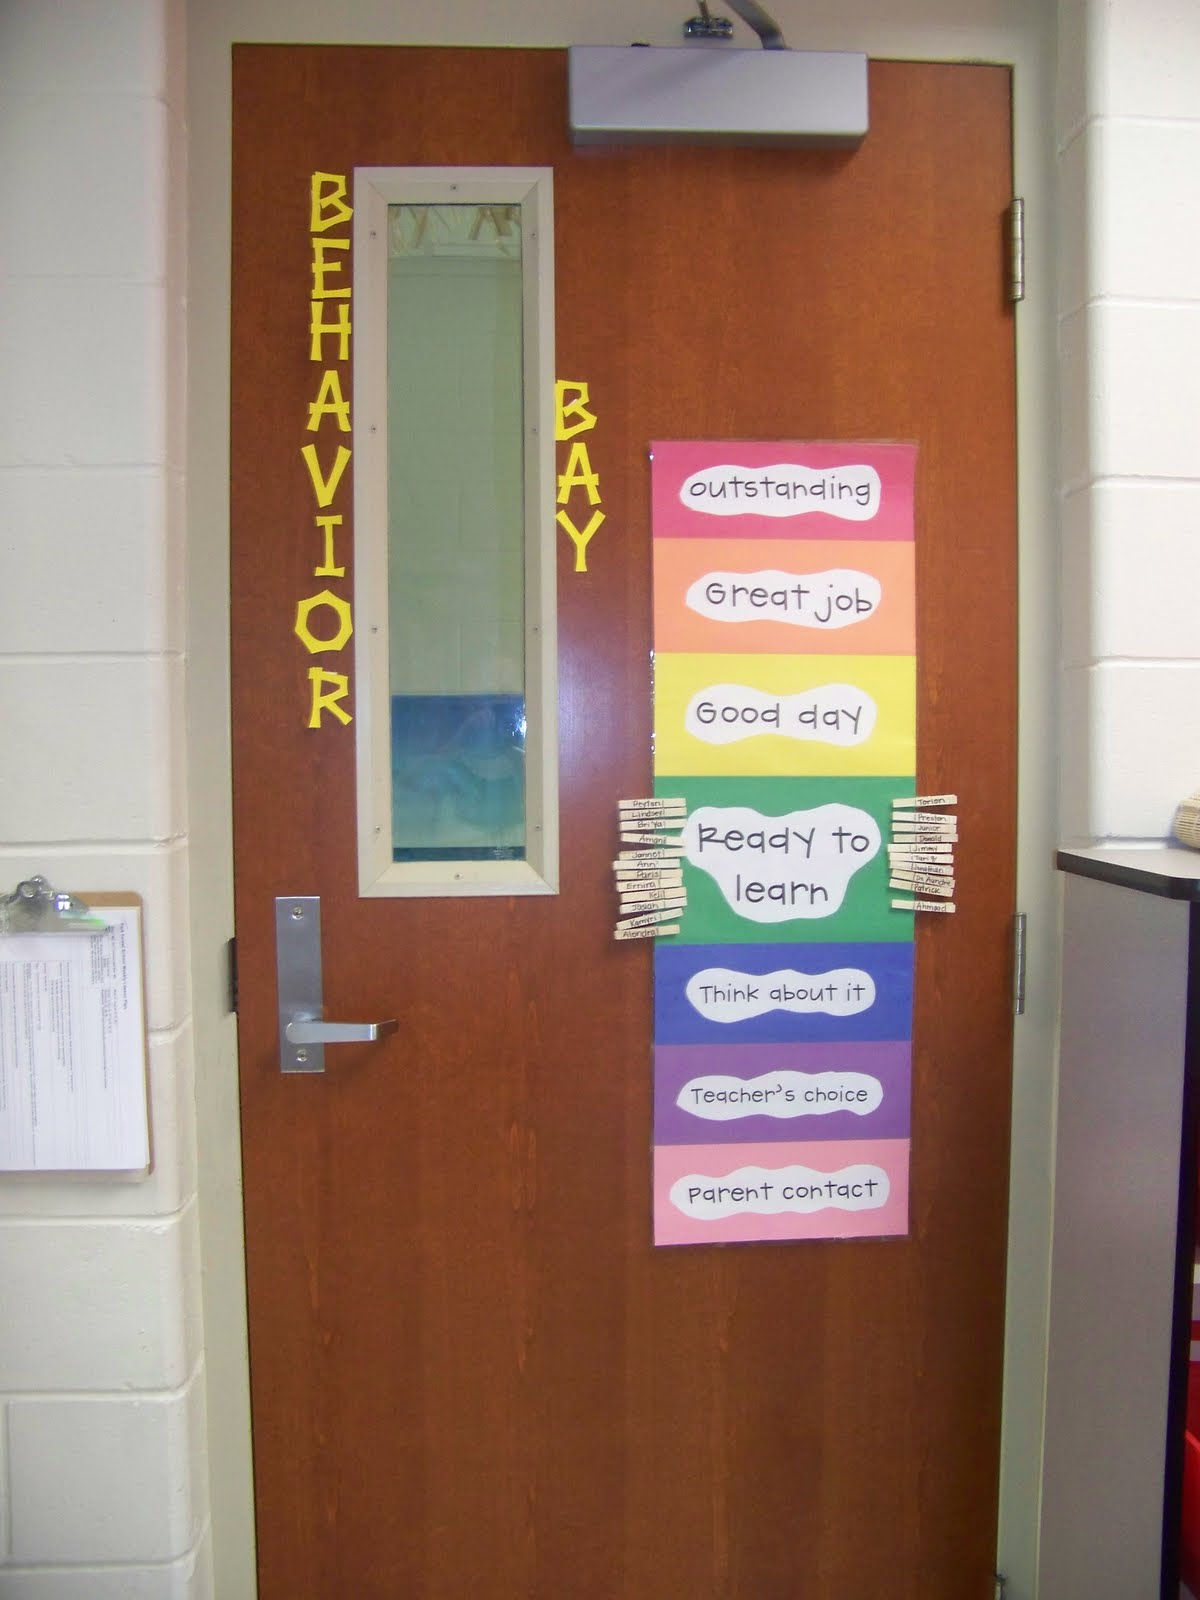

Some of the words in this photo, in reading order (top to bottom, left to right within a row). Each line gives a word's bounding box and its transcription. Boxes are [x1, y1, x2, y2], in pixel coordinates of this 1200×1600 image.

[294, 171, 353, 728] BEHAVIOR
[555, 380, 606, 572] BAY
[706, 582, 810, 608] Great
[814, 583, 873, 623] job
[697, 702, 781, 729] Good
[798, 704, 862, 735] day
[632, 810, 662, 818] Lindsey
[633, 800, 660, 808] Peyton
[918, 814, 946, 822] Preston
[699, 823, 816, 859] Ready
[832, 825, 871, 853] to
[913, 844, 938, 852] Jimmy
[919, 834, 942, 842] Donald
[636, 870, 659, 878] Paris
[737, 874, 828, 905] learn
[915, 885, 941, 894] Patrick
[699, 983, 761, 1004] Think
[769, 984, 838, 1002] about
[846, 983, 866, 1002] it
[691, 1084, 796, 1105] Teacher's
[804, 1085, 869, 1103] choice
[688, 1183, 774, 1204] Parent
[782, 1179, 879, 1200] contact
